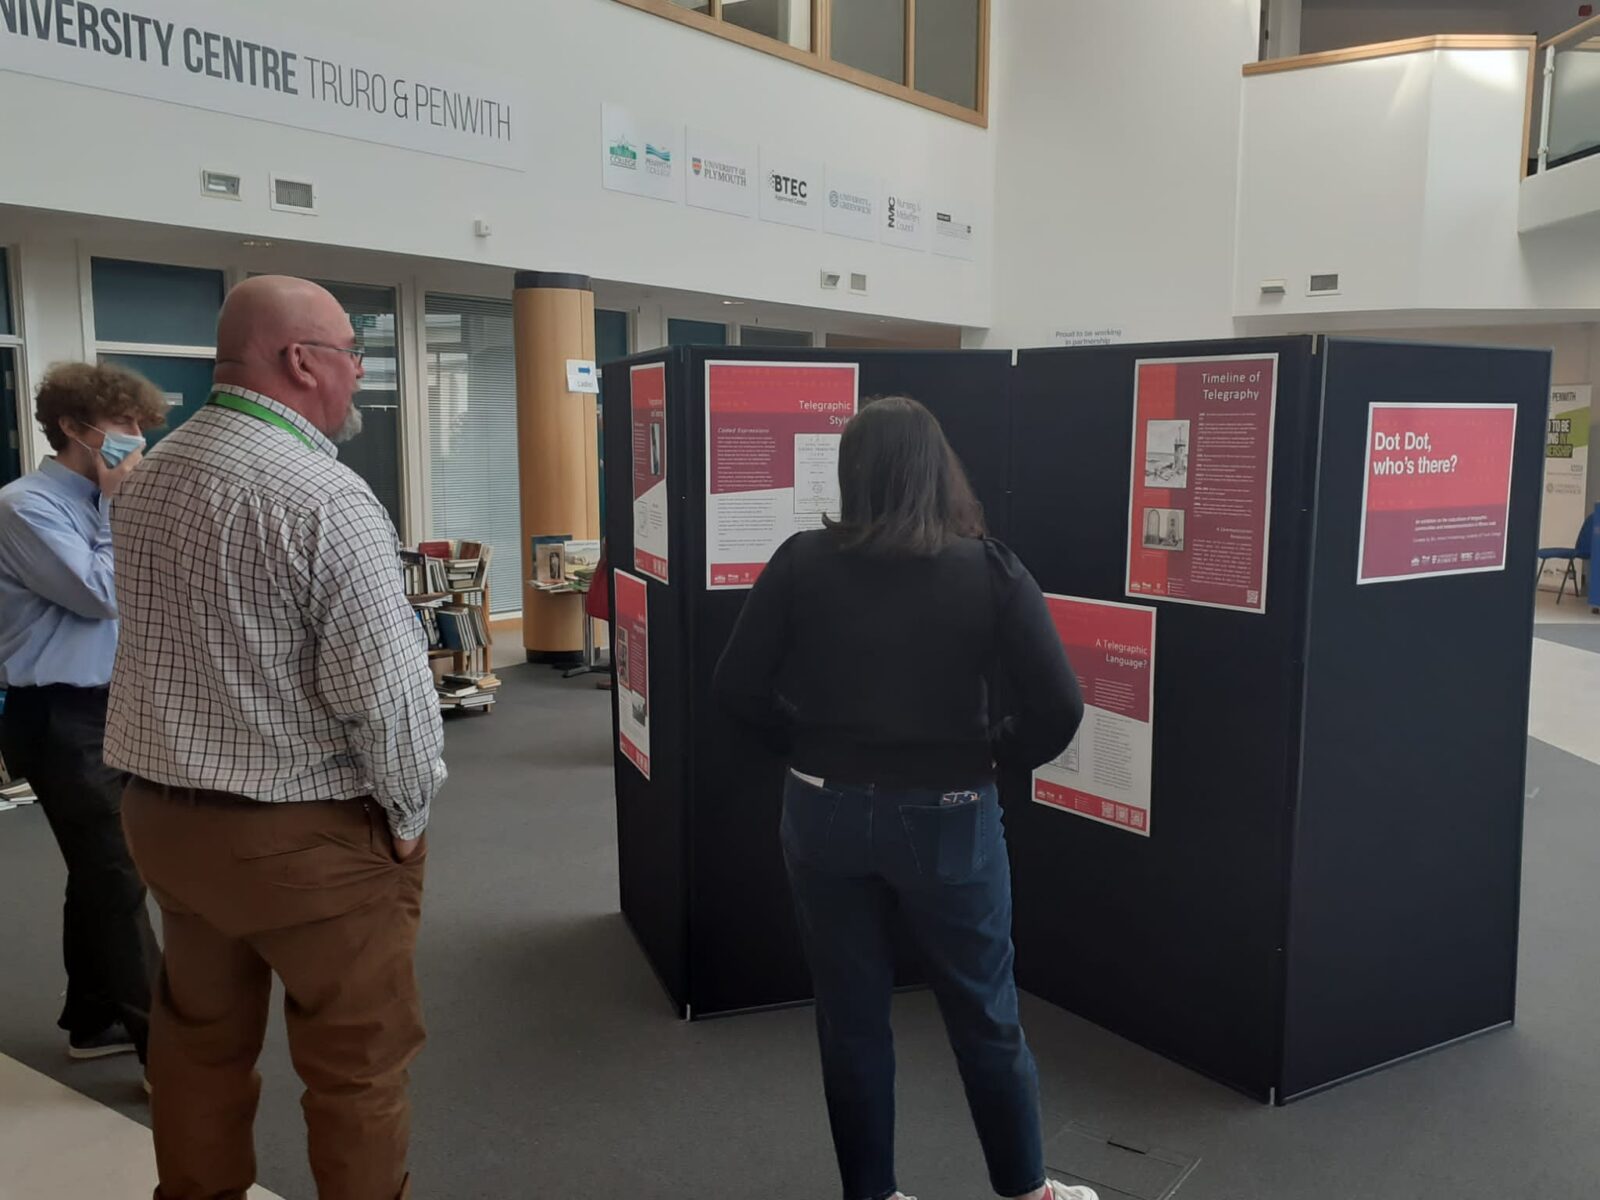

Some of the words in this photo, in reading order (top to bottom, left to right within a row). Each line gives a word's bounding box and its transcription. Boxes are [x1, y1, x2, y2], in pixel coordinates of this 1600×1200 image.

[183, 27, 299, 95] CENTRE
[303, 55, 387, 114] TRURO
[393, 78, 409, 119] &
[415, 83, 511, 141] PENWITH
[704, 159, 738, 174] UNIVERSITY
[738, 167, 746, 176] OF
[704, 169, 747, 187] PLYMOUTH
[774, 174, 808, 198] BTEC
[887, 195, 896, 229] NMC
[1202, 372, 1245, 385] Timeline
[1249, 370, 1261, 383] of
[1203, 388, 1260, 402] Telegraphy
[799, 400, 852, 412] Telegraphic
[1374, 432, 1401, 450] Dot
[1404, 432, 1432, 452] Dot,
[1373, 456, 1415, 475] who's
[1417, 454, 1458, 474] there?
[1095, 638, 1102, 648] A
[1103, 639, 1148, 655] Telegraphic
[1105, 654, 1148, 669] Language?
